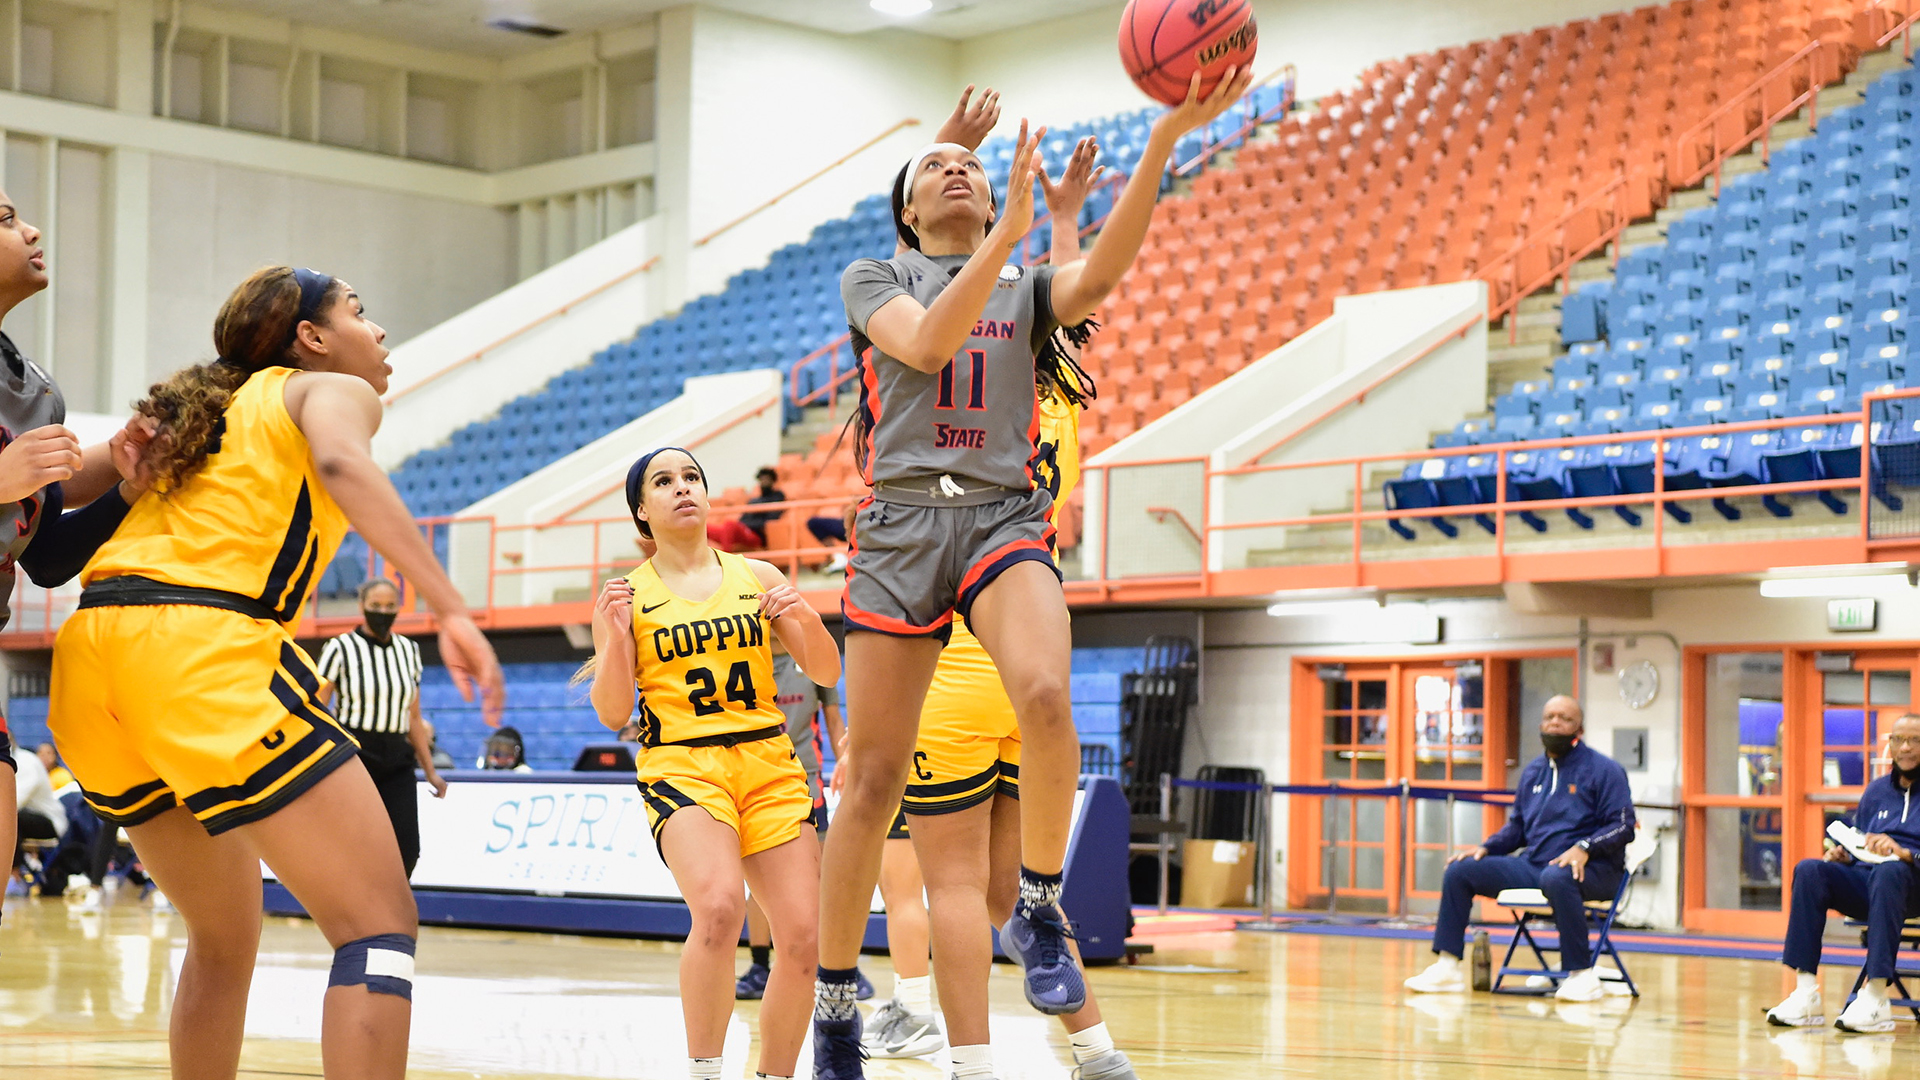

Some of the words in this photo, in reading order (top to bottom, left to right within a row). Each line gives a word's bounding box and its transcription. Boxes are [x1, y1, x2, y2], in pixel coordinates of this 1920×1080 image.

[971, 319, 1015, 340] GAN
[934, 349, 987, 411] 11
[653, 612, 764, 663] COPPIN
[685, 661, 758, 717] 24
[913, 750, 934, 781] C
